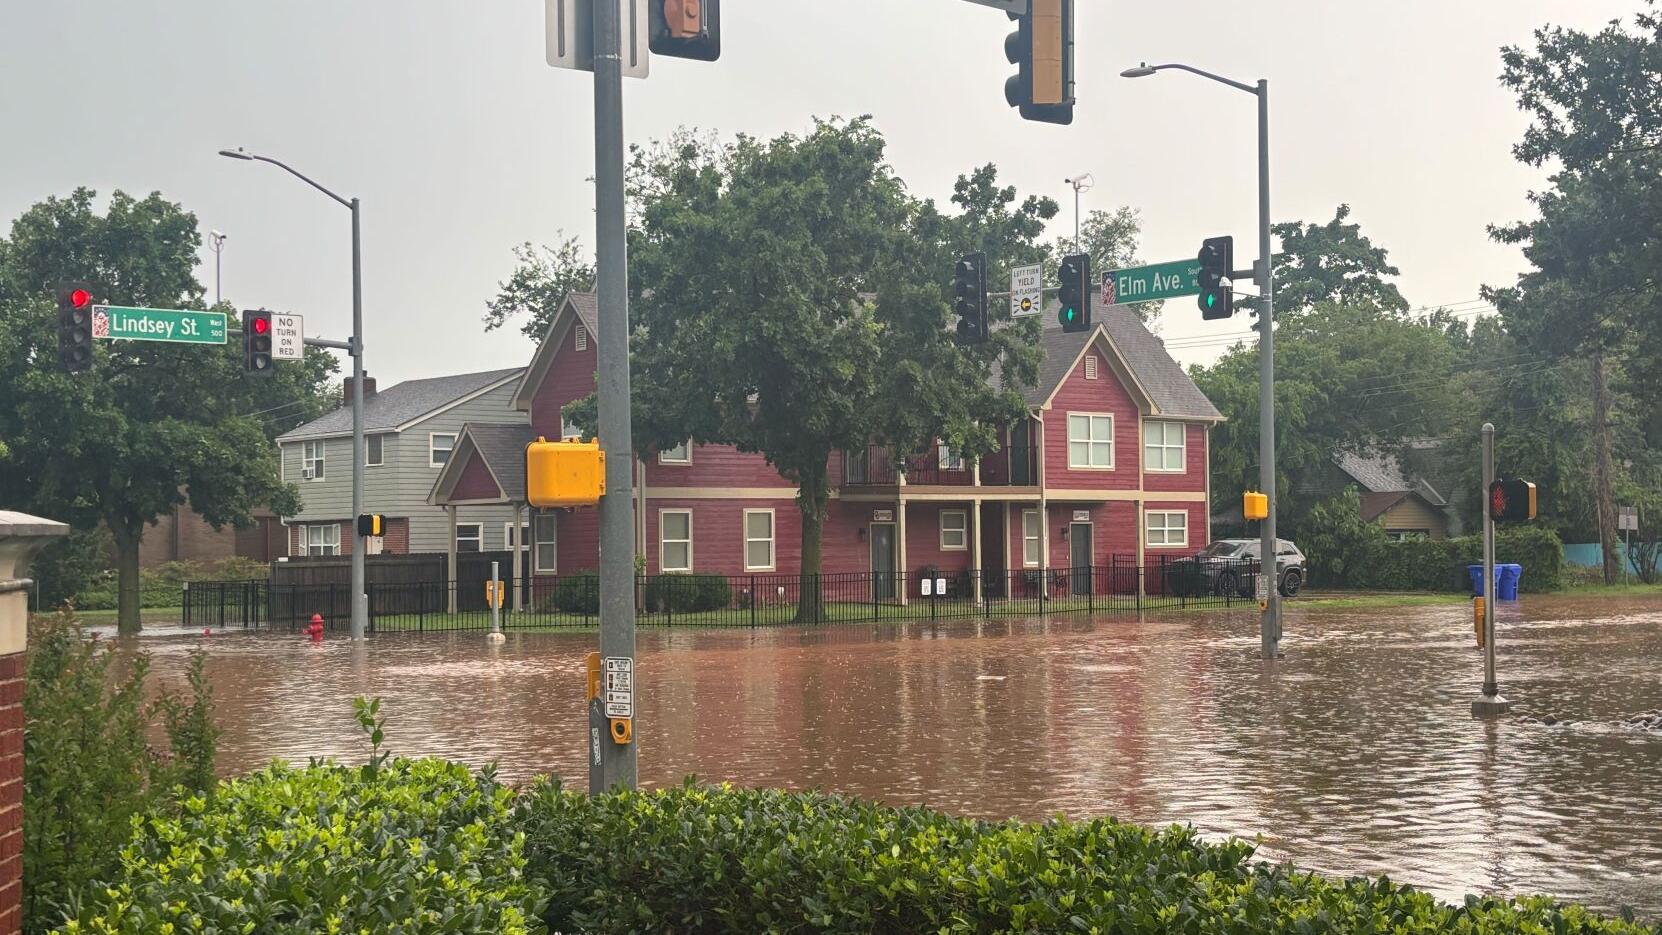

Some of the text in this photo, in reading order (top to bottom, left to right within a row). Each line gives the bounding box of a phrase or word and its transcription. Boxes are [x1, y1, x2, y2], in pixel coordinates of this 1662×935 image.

[1018, 277, 1035, 287] YIELD
[1119, 272, 1184, 297] Elm Ave.
[112, 313, 201, 338] Lindsey St.
[209, 319, 223, 327] West
[279, 318, 293, 327] NO
[210, 329, 223, 337] 500
[276, 328, 297, 336] TURN
[281, 338, 292, 346] ON
[279, 347, 295, 356] RED
